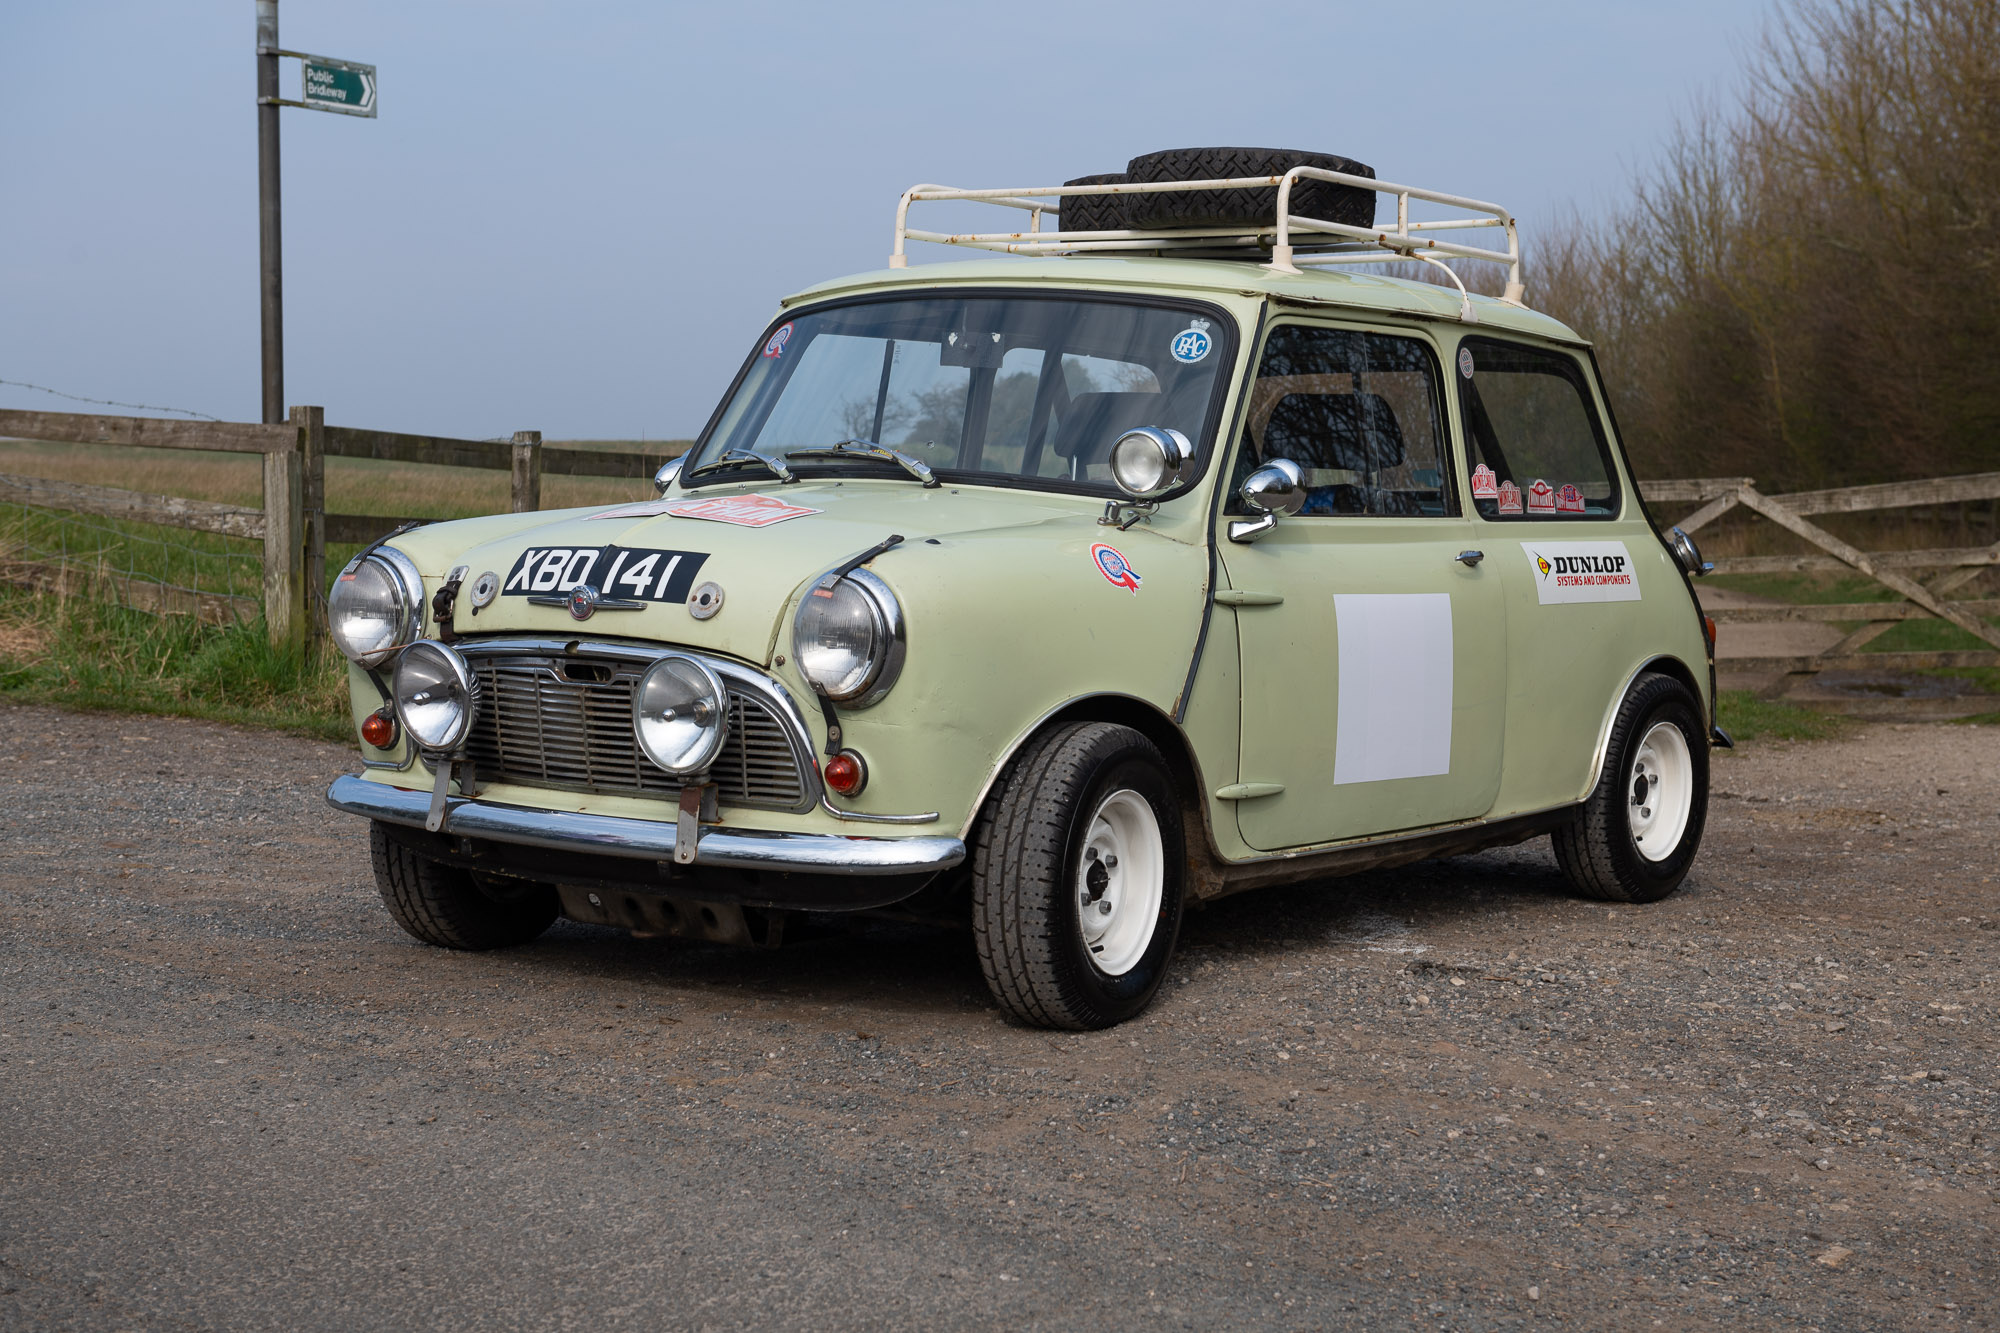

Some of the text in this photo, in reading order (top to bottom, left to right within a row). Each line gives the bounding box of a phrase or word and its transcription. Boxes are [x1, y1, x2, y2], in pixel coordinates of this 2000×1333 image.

[307, 68, 335, 84] Public
[307, 82, 347, 101] Bridleway
[1176, 334, 1207, 357] RAC
[1553, 556, 1625, 574] DUNLOP
[505, 550, 682, 599] XBD 141
[1557, 574, 1631, 587] SYSTEMS AND COMPONENTS
